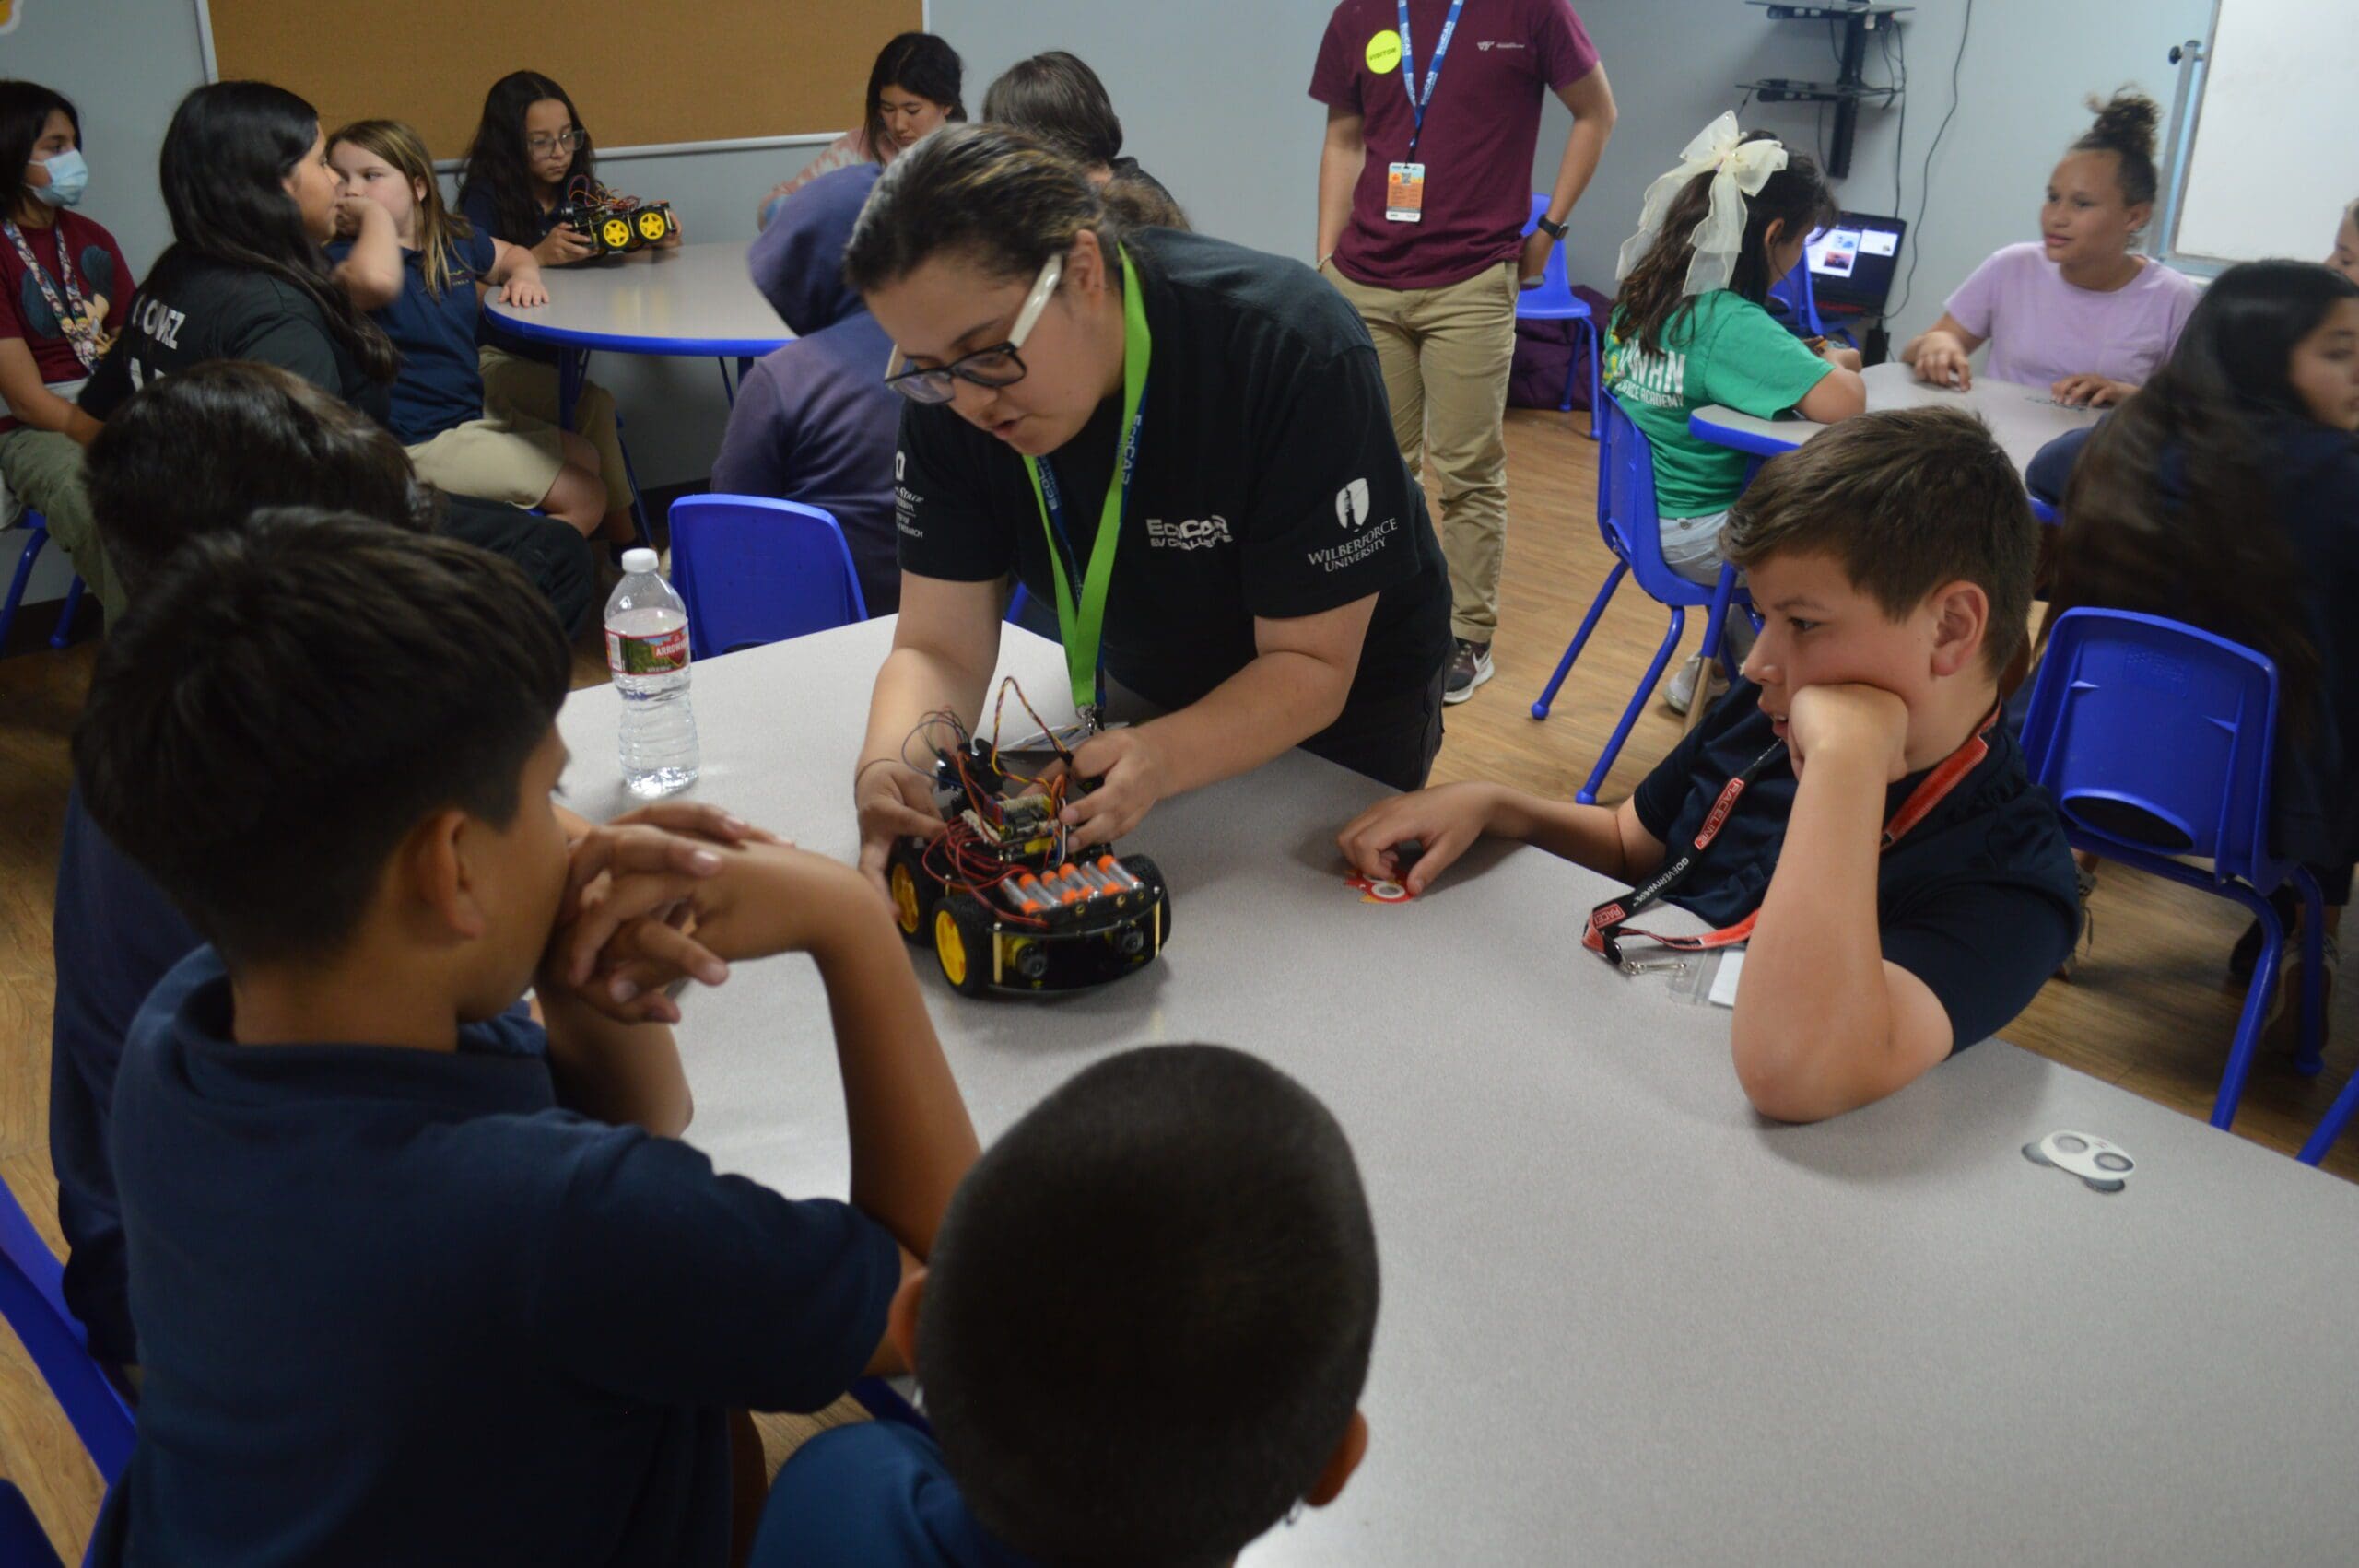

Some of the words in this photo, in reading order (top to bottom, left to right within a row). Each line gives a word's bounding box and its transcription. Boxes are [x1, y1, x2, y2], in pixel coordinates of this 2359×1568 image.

[1368, 47, 1396, 61] VISITOR
[1640, 387, 1684, 408] ACADEMY
[1308, 517, 1399, 565] WILBERFORCE
[1324, 536, 1387, 572] UNIVERSITY
